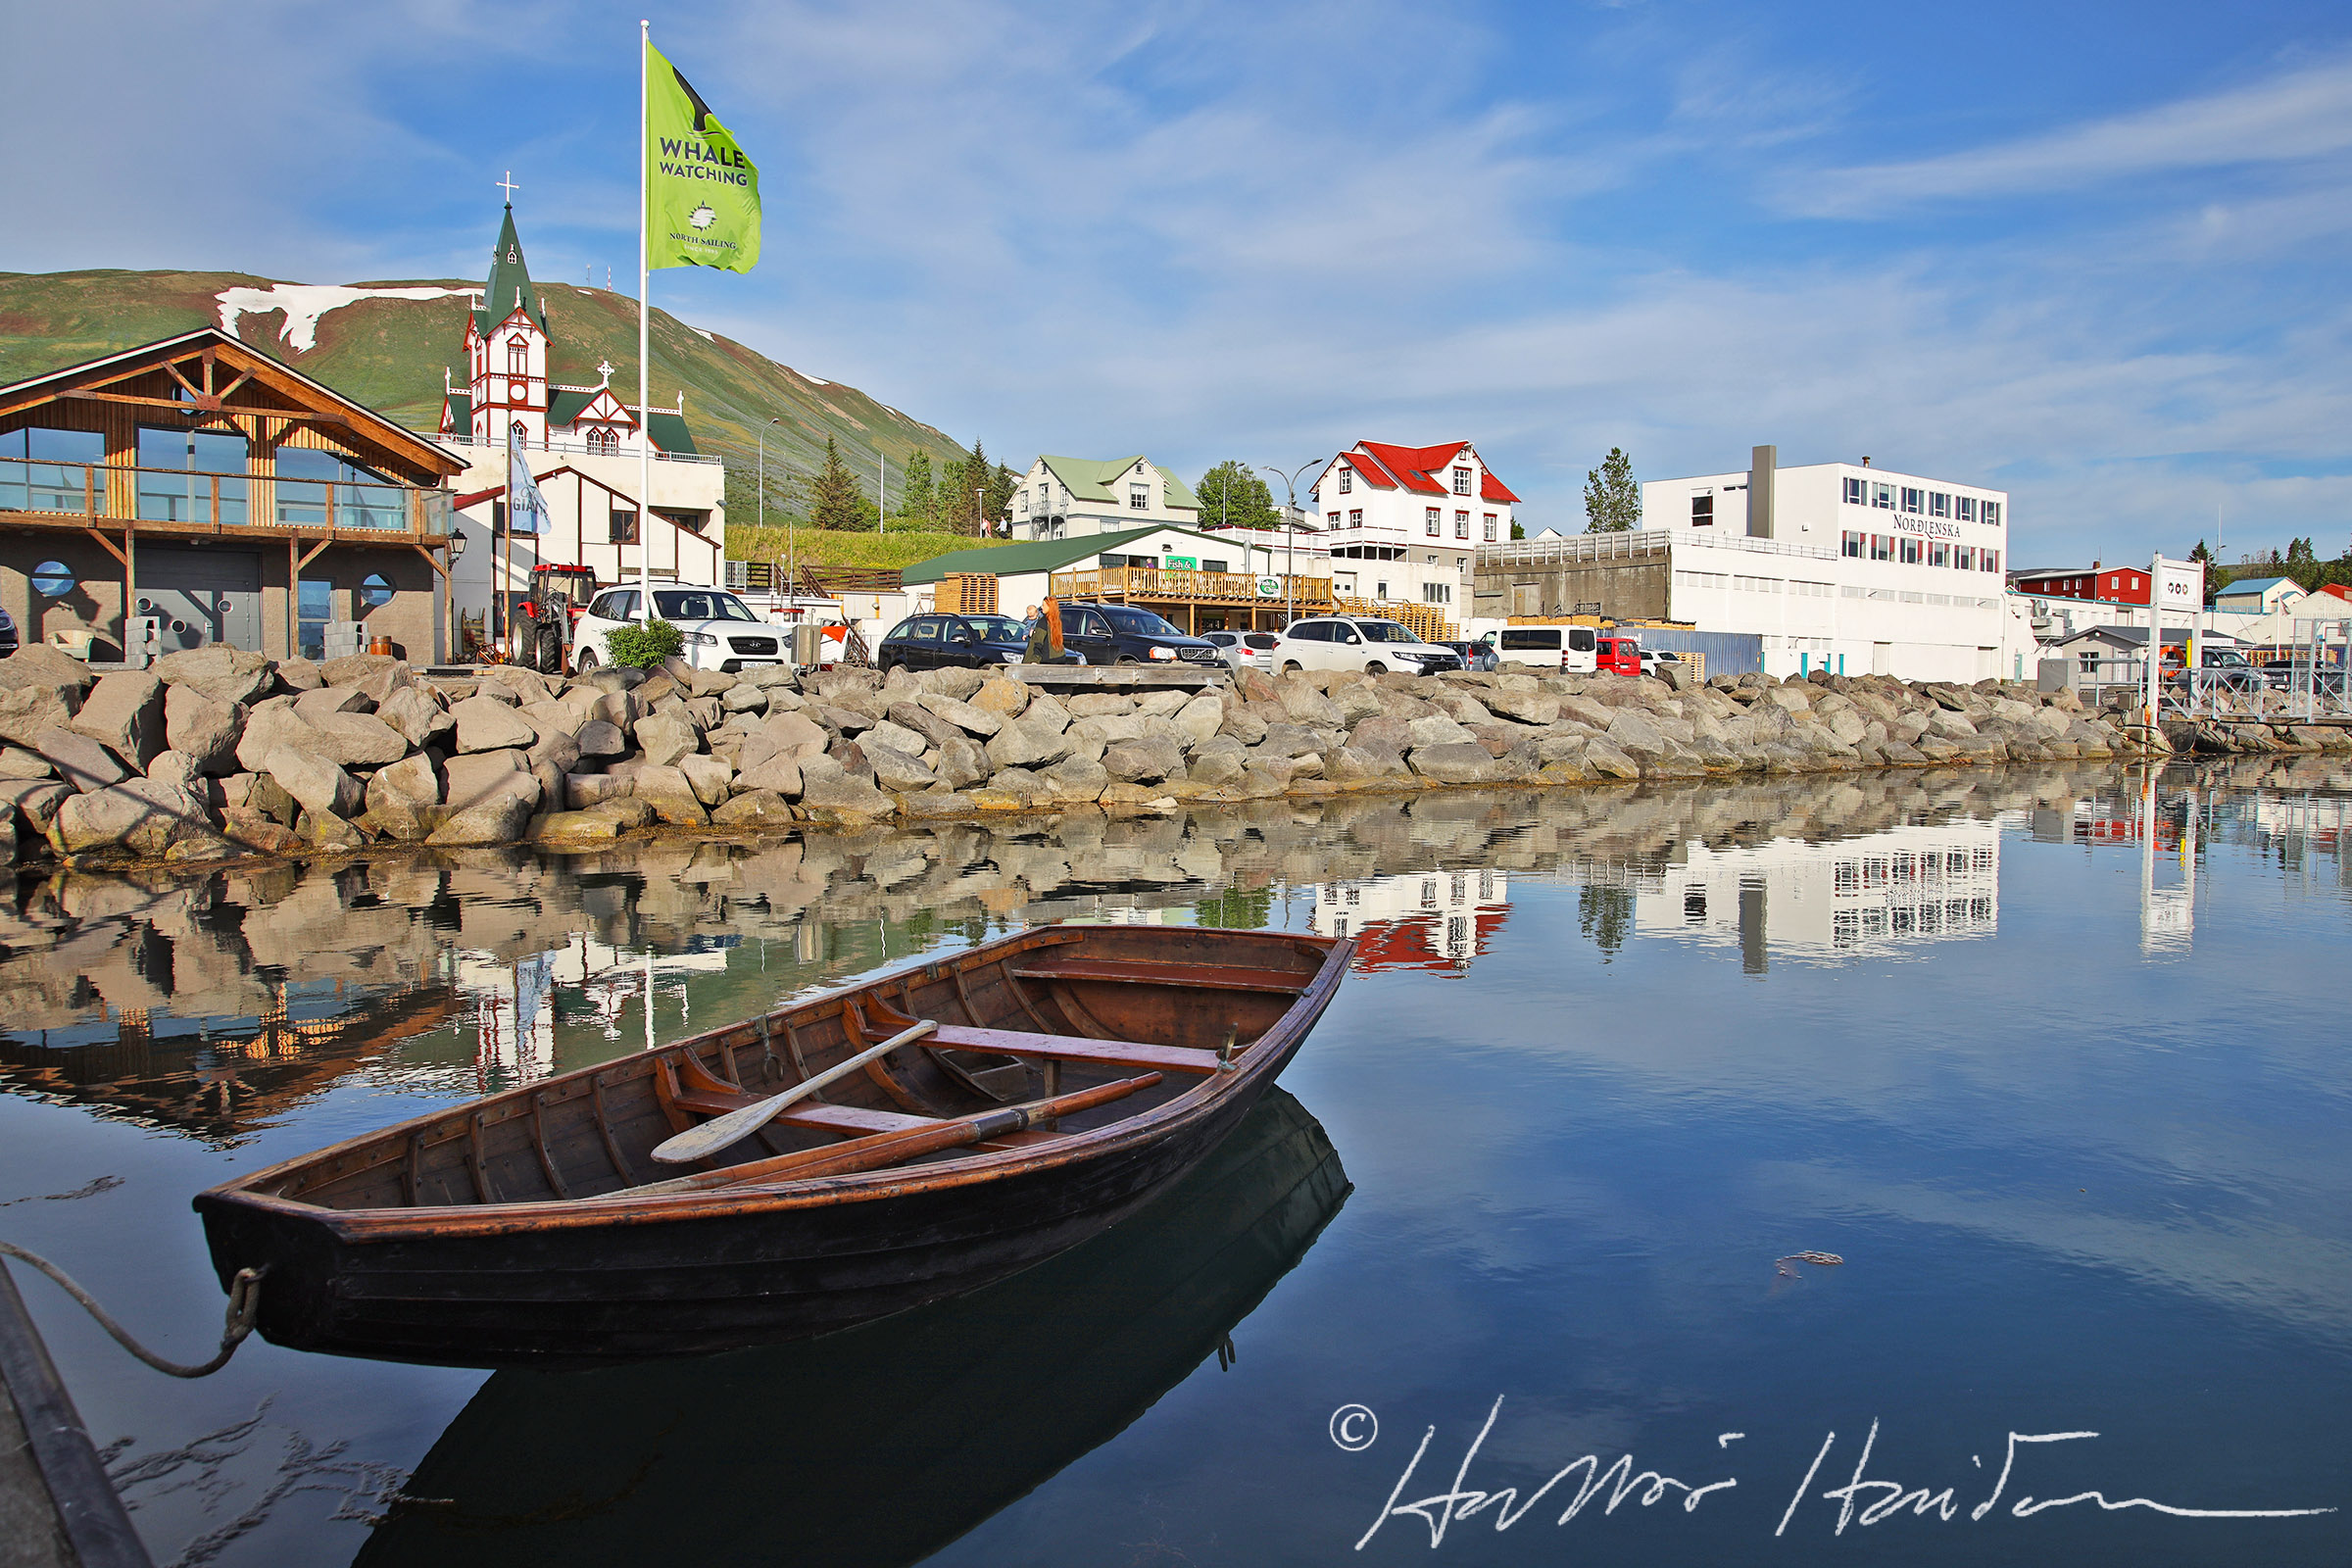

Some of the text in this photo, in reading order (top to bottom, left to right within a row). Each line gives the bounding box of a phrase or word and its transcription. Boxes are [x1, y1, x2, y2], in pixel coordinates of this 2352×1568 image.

[660, 136, 746, 170] WHALE
[660, 161, 748, 186] WATCHING
[669, 232, 737, 249] NORTH SAILING
[1167, 559, 1183, 568] Fish
